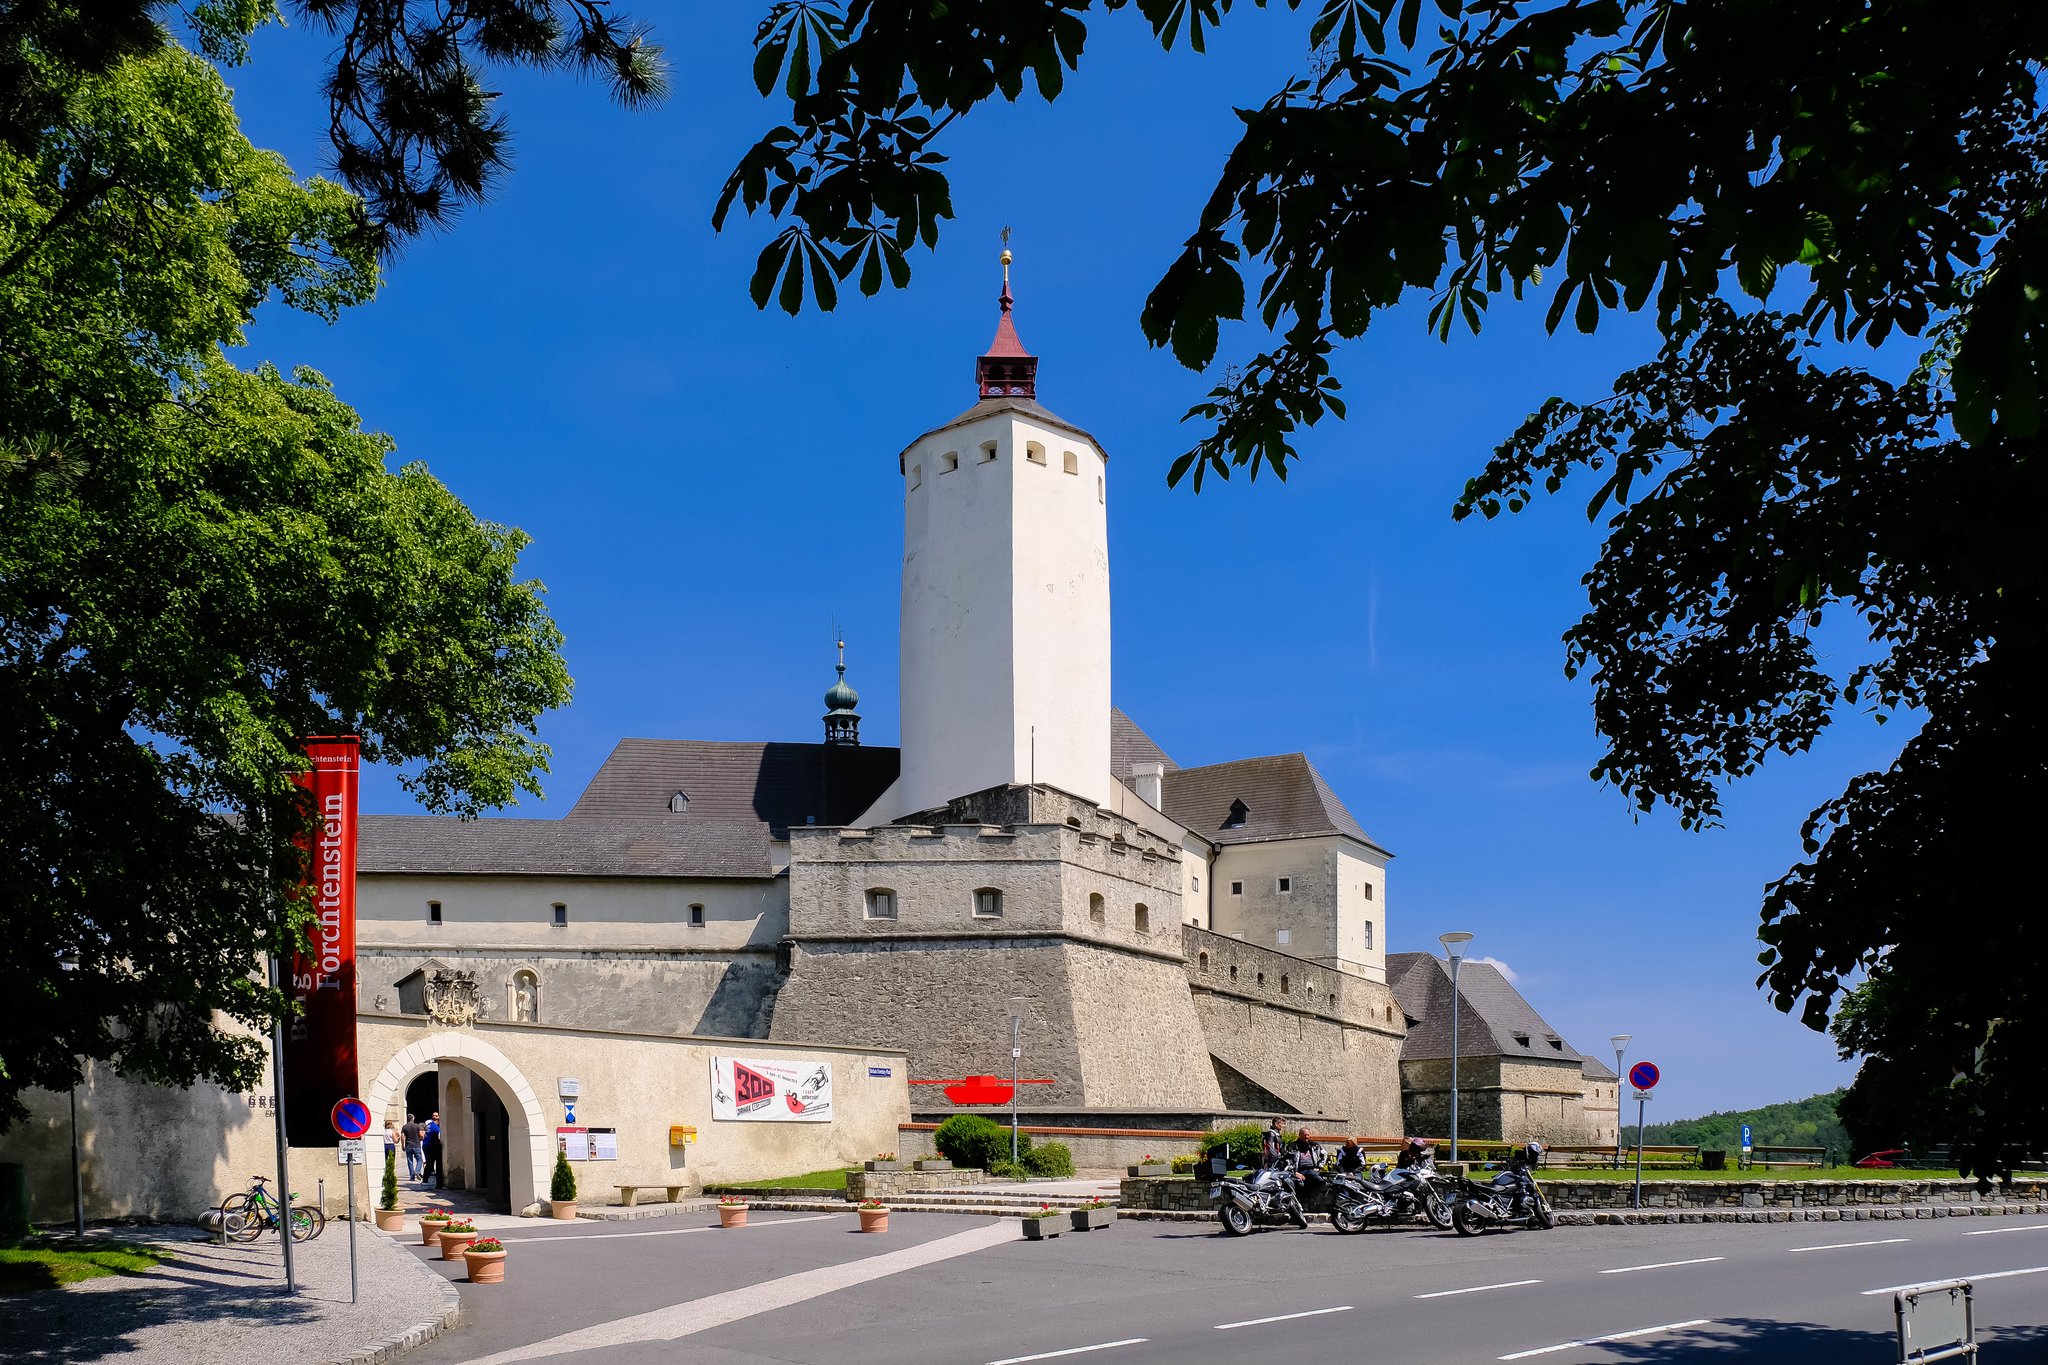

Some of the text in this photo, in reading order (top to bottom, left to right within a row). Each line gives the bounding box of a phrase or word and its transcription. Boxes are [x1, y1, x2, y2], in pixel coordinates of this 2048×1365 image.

[310, 755, 352, 763] chtenstein
[316, 793, 343, 991] Forchtenstein
[736, 1066, 773, 1102] 300
[791, 1092, 798, 1106] 3
[1744, 1127, 1750, 1142] P
